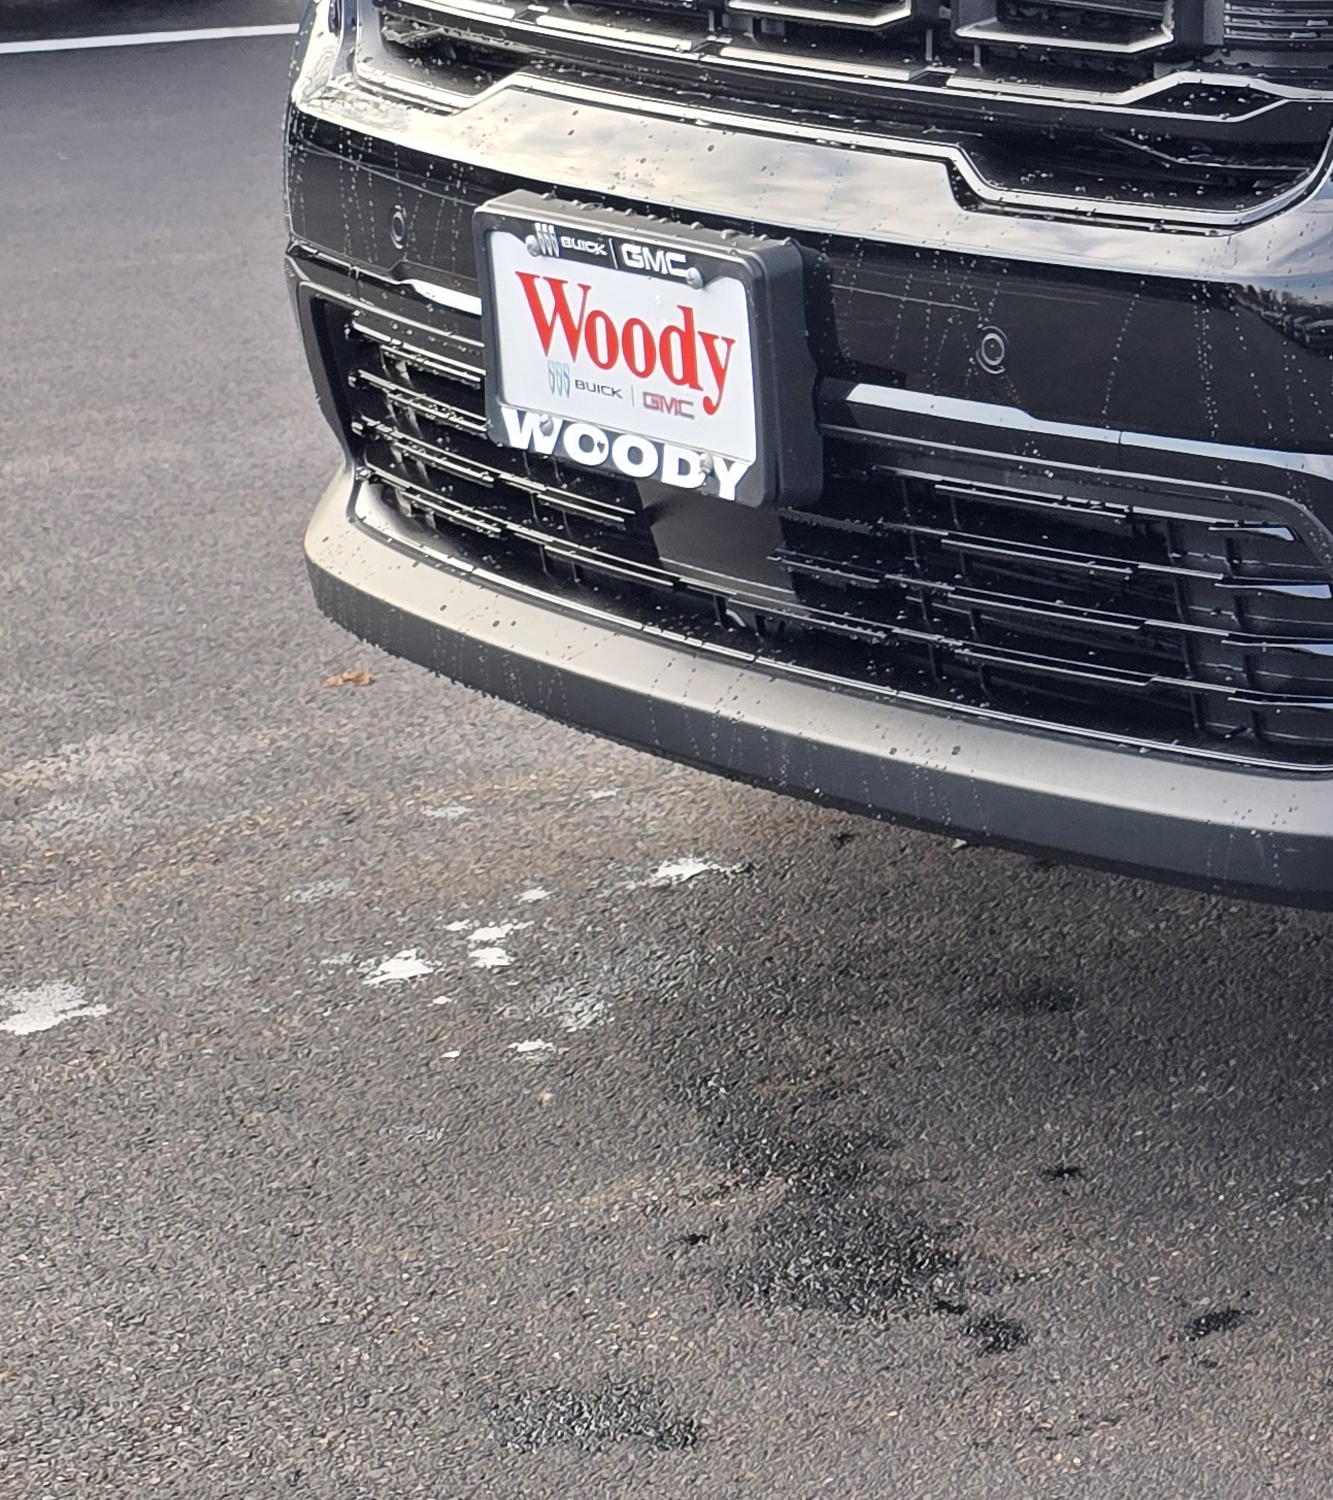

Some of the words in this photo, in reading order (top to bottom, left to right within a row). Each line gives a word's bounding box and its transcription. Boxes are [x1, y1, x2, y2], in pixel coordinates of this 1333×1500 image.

[560, 235, 607, 257] BUICK
[620, 242, 687, 277] GMC
[514, 271, 736, 416] Woody
[574, 378, 623, 399] BUICK
[642, 390, 695, 421] GMC
[500, 406, 753, 501] WOODY
